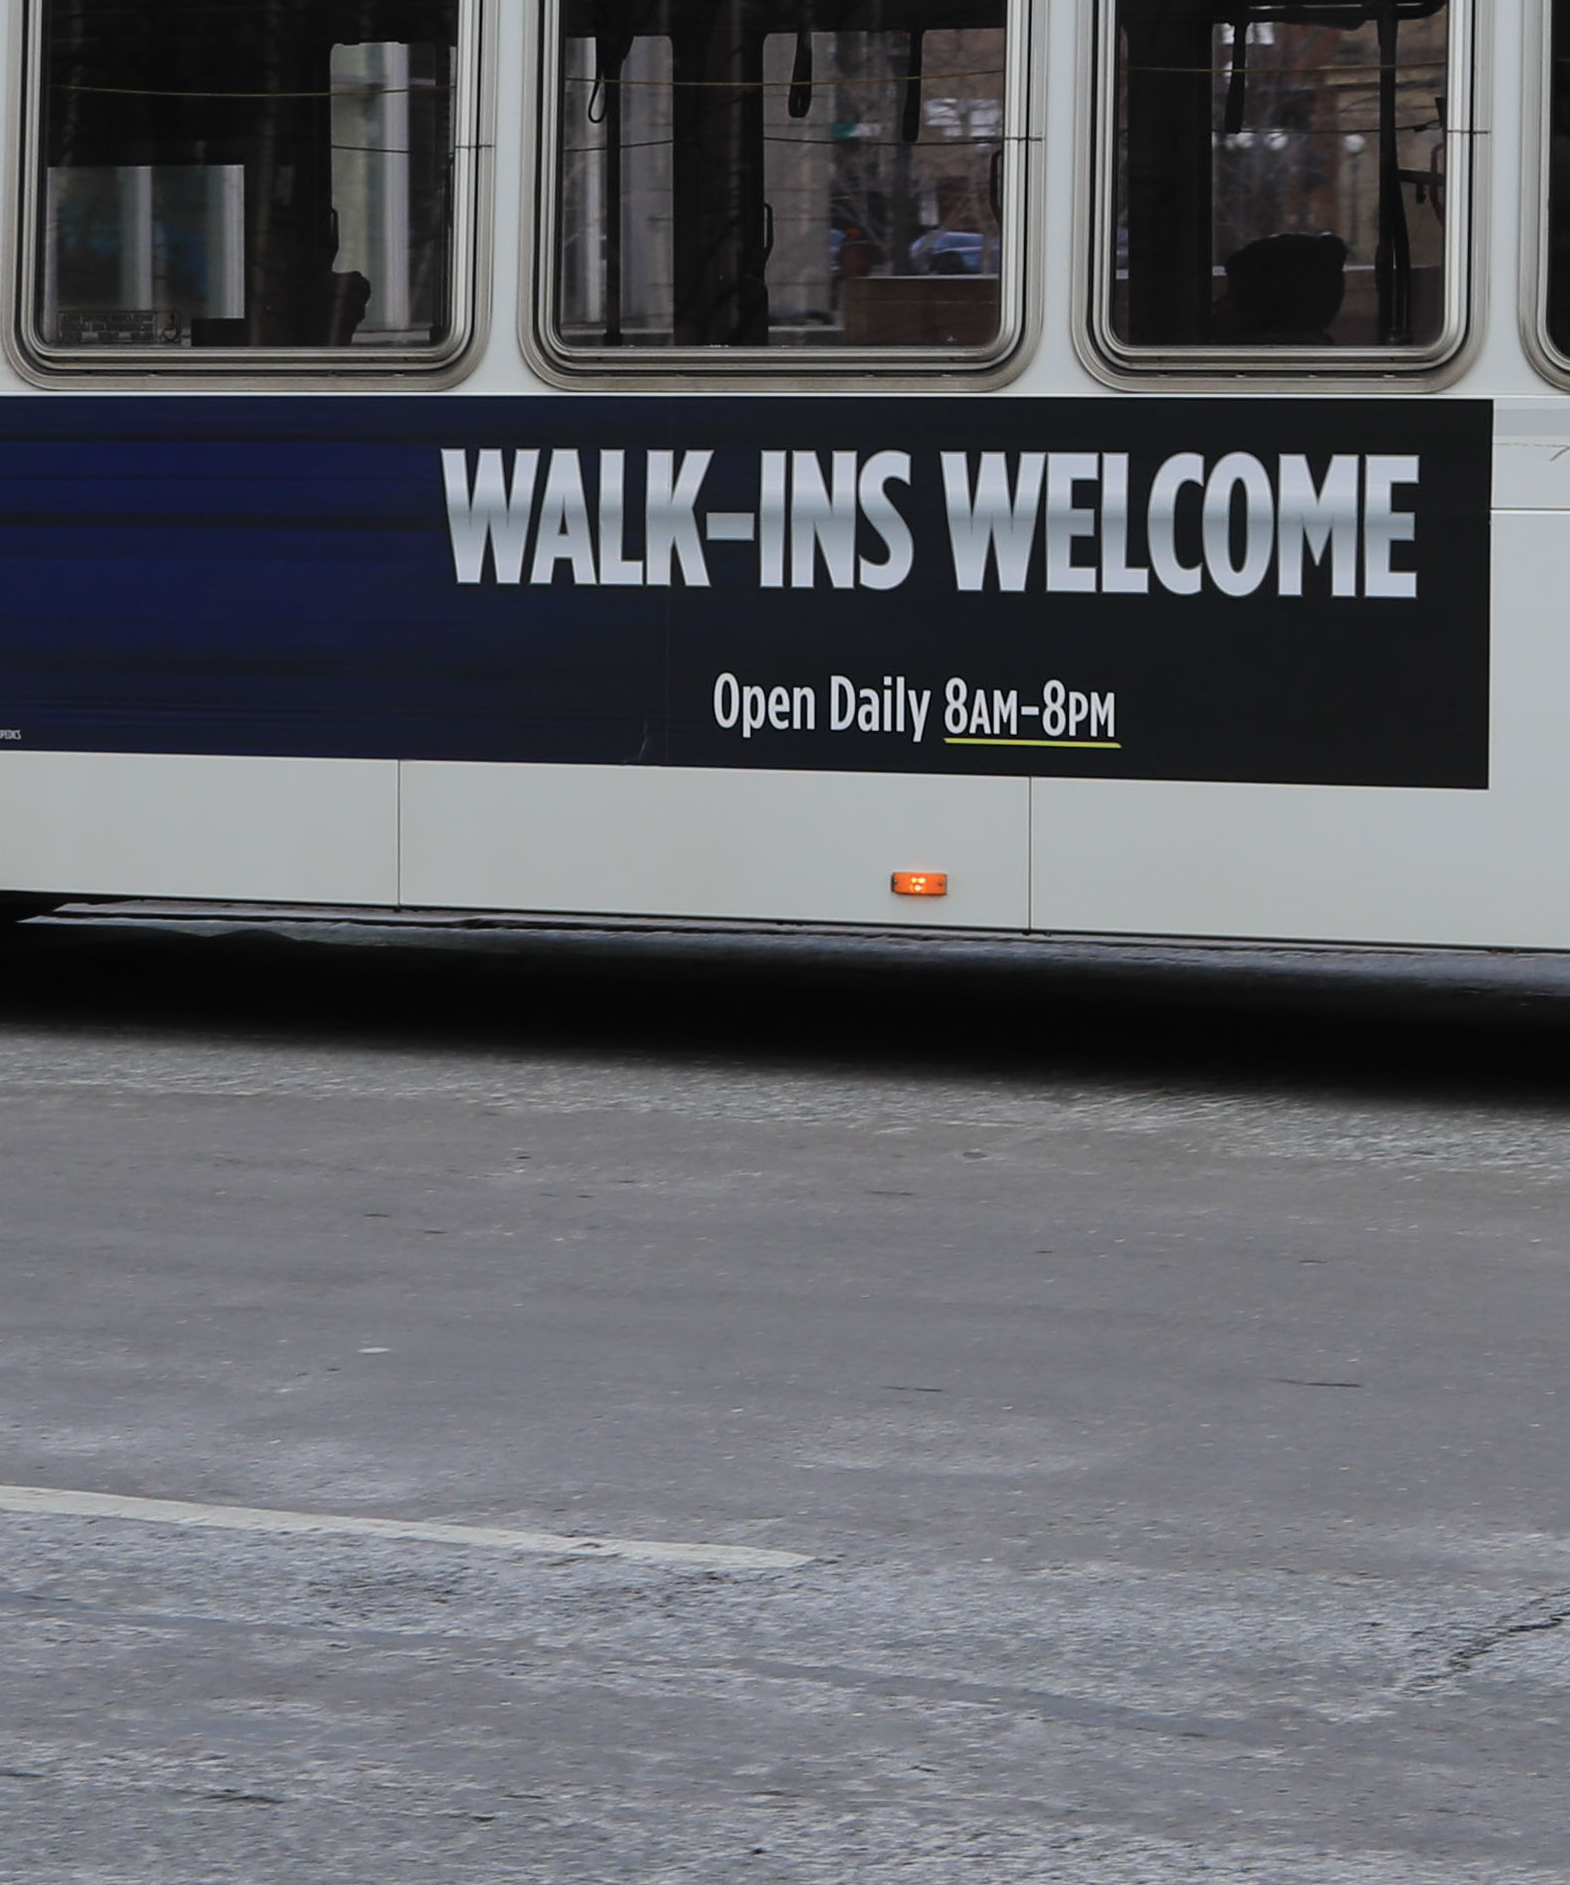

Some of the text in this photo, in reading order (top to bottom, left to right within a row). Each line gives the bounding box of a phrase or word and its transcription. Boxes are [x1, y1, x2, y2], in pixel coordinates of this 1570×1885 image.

[440, 448, 1420, 599] WALK-INS WELCOME
[713, 672, 1117, 743] Open Daily 8AM-8PM
